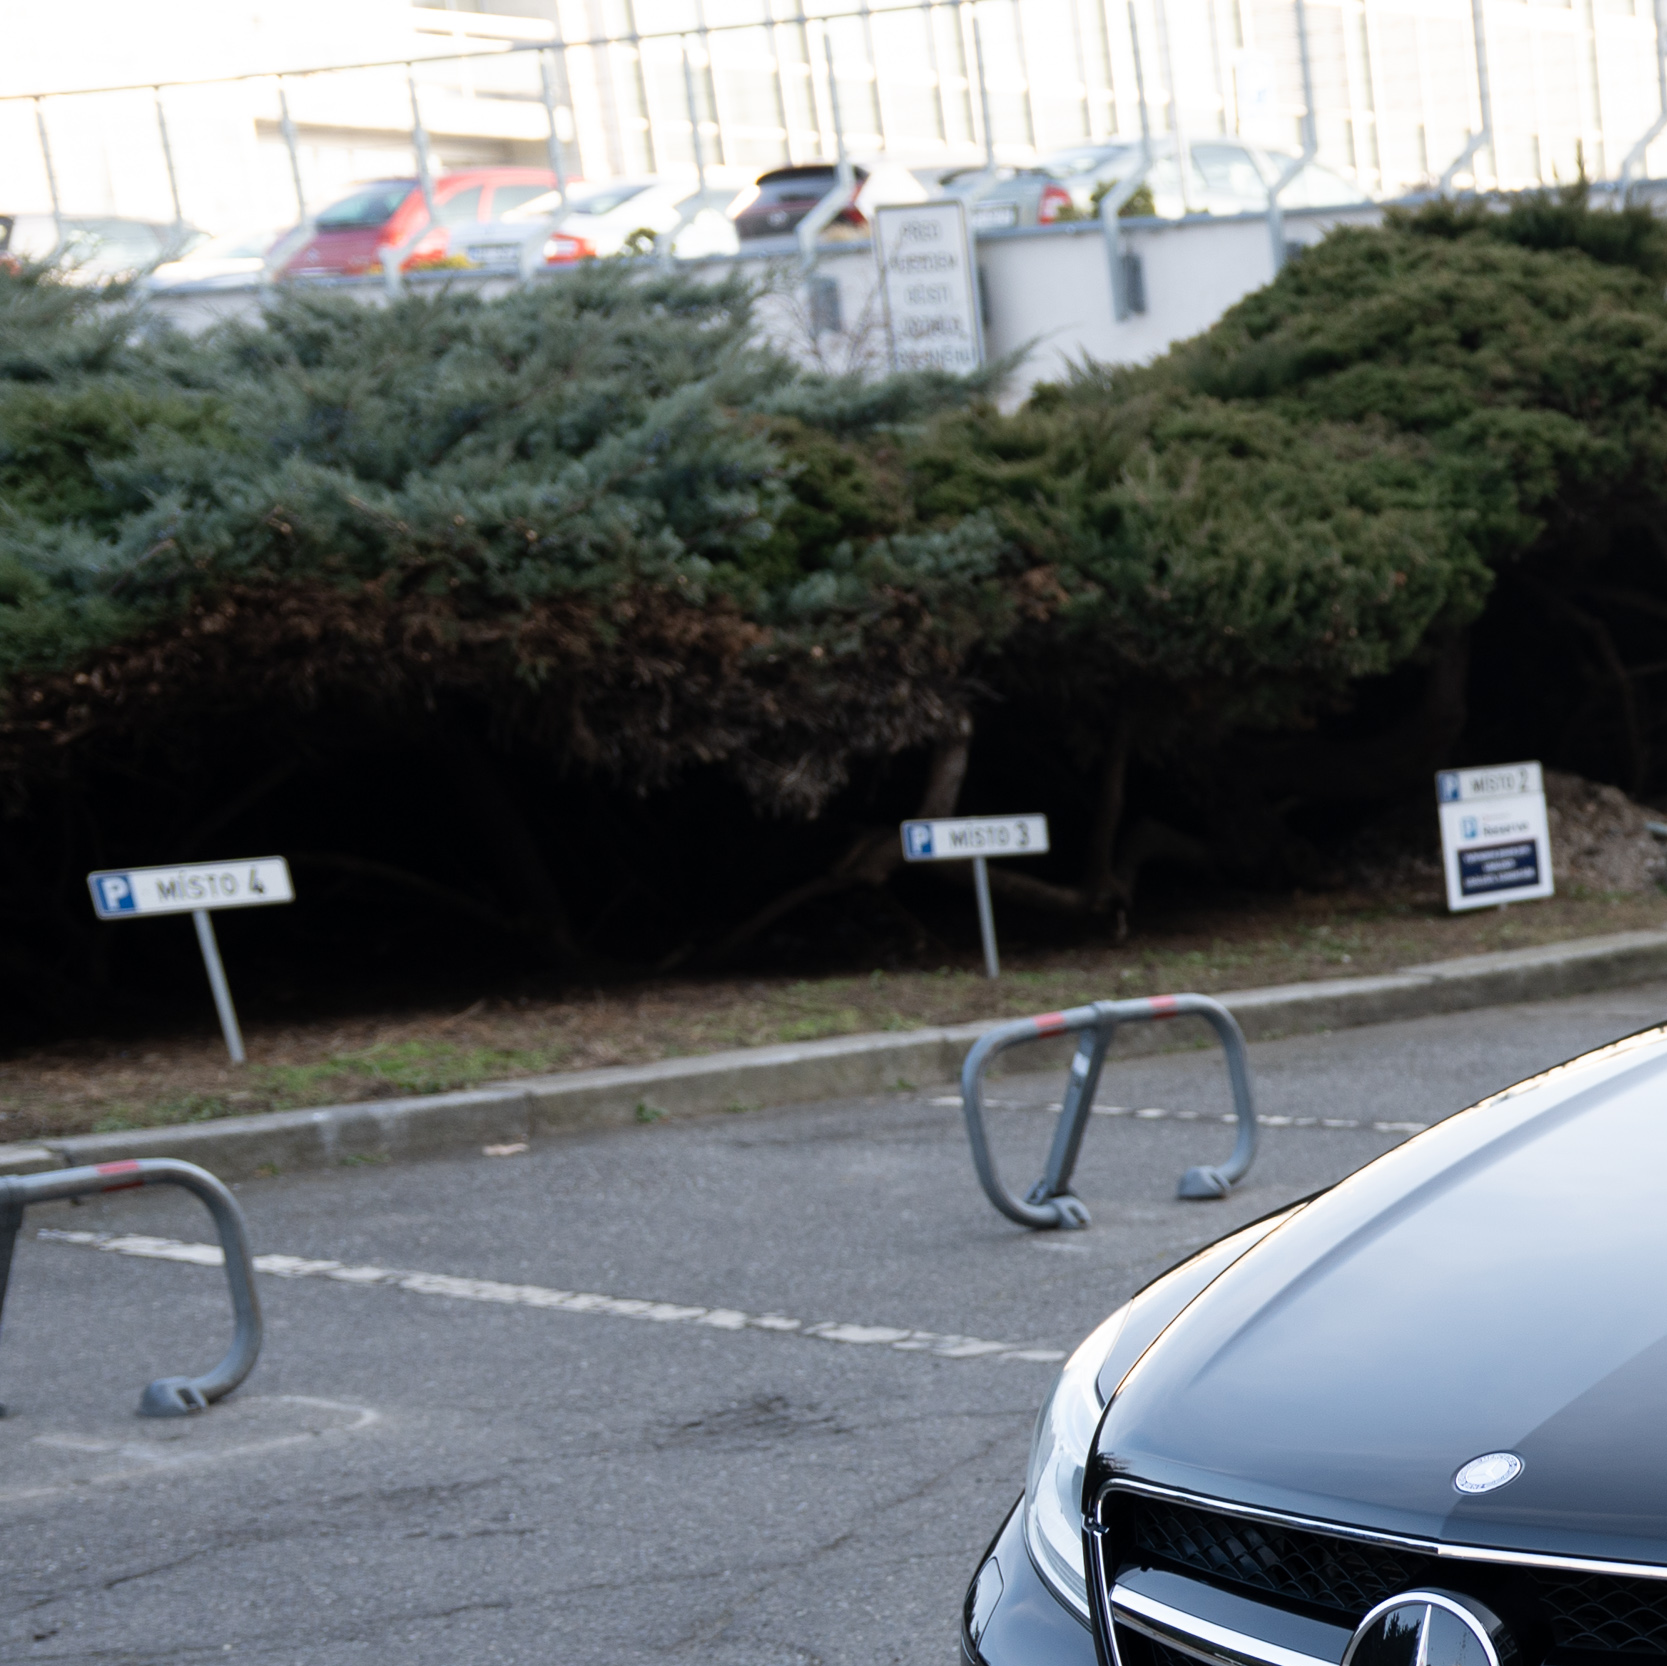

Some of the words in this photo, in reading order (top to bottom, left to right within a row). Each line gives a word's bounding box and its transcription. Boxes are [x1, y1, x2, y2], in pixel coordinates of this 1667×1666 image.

[1518, 767, 1528, 792] 2
[950, 821, 1010, 848] MÍSTO
[1015, 820, 1029, 847] 3
[156, 869, 238, 902] MÍSTO
[249, 867, 265, 895] 4
